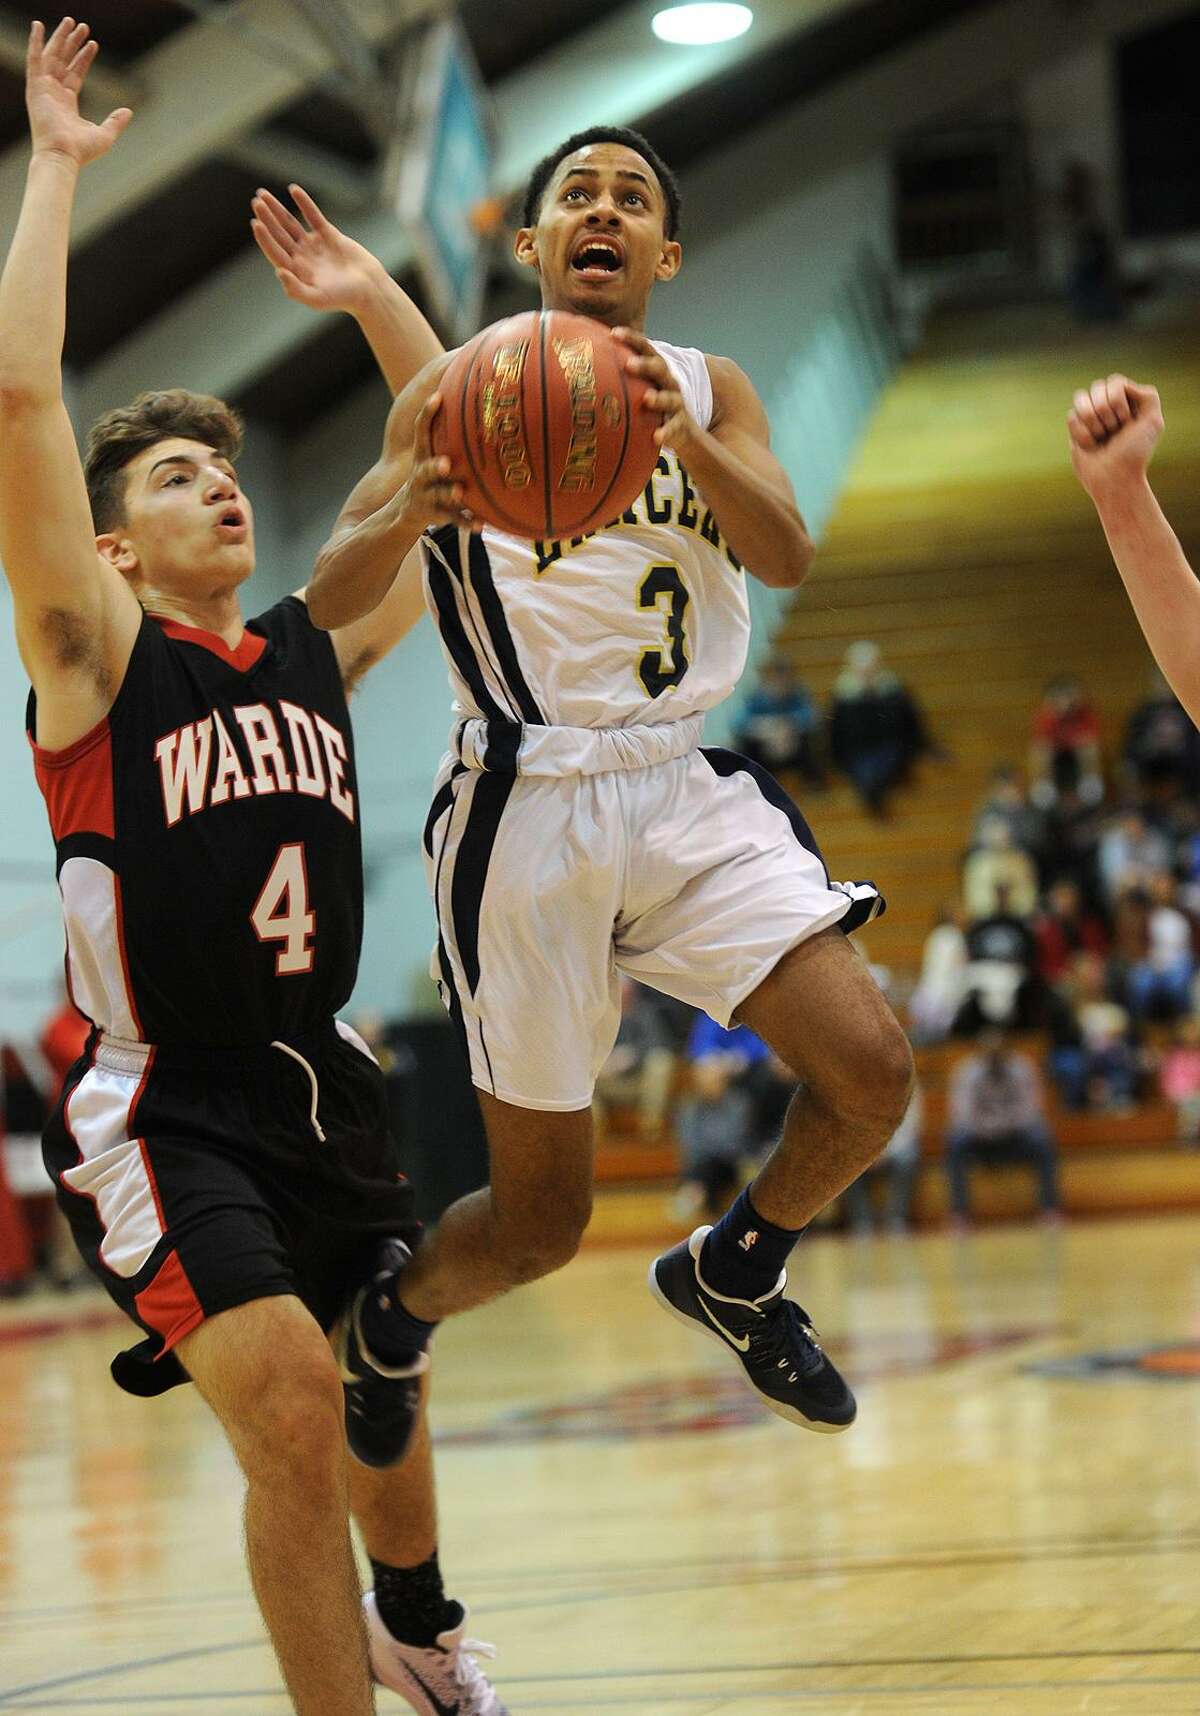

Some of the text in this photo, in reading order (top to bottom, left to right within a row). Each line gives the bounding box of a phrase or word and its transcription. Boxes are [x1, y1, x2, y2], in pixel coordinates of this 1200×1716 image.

[635, 560, 693, 700] 3
[153, 699, 355, 829] WARDE
[250, 841, 317, 977] 4
